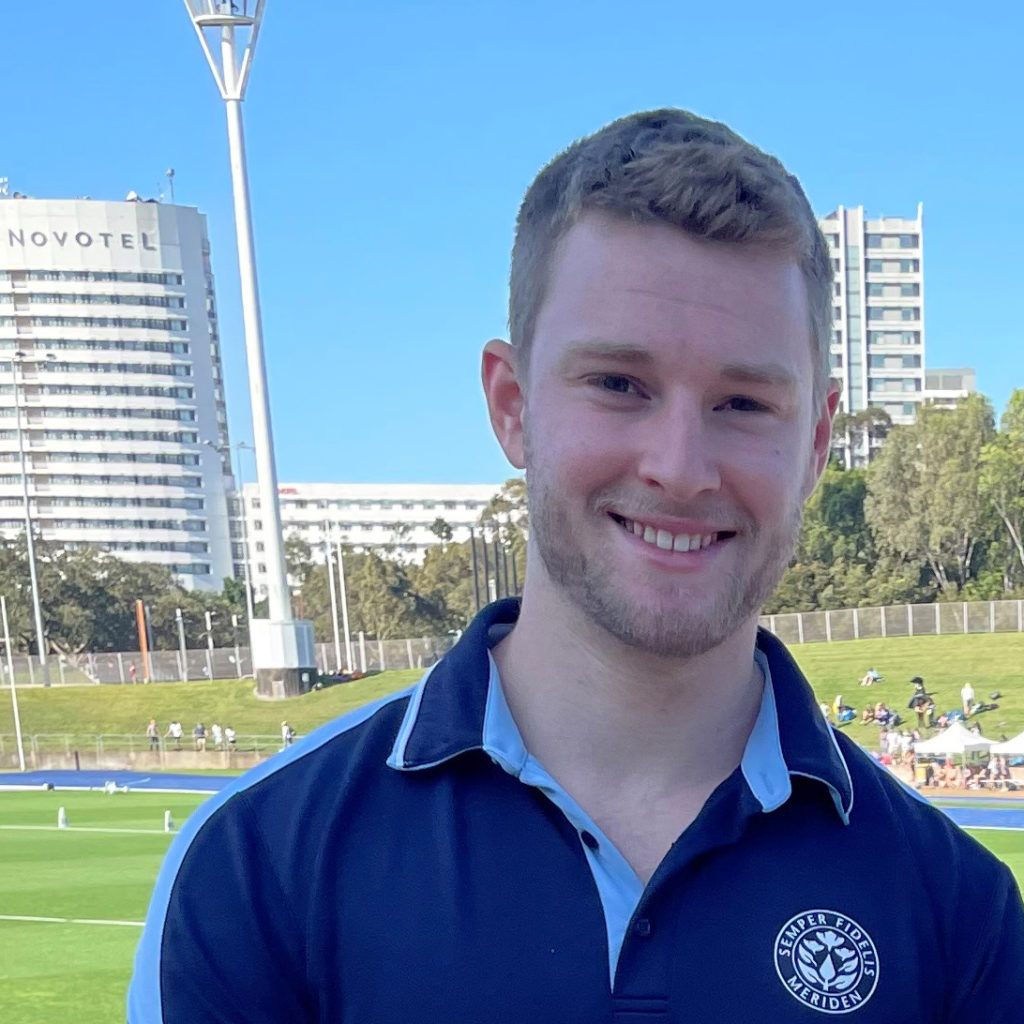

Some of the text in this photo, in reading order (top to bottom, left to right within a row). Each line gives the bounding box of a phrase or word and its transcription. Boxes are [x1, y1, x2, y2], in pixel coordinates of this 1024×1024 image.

[8, 229, 157, 251] NOVOTEL
[779, 913, 875, 977] SEMPER FIDELIS
[787, 975, 862, 1010] MERIDEN
